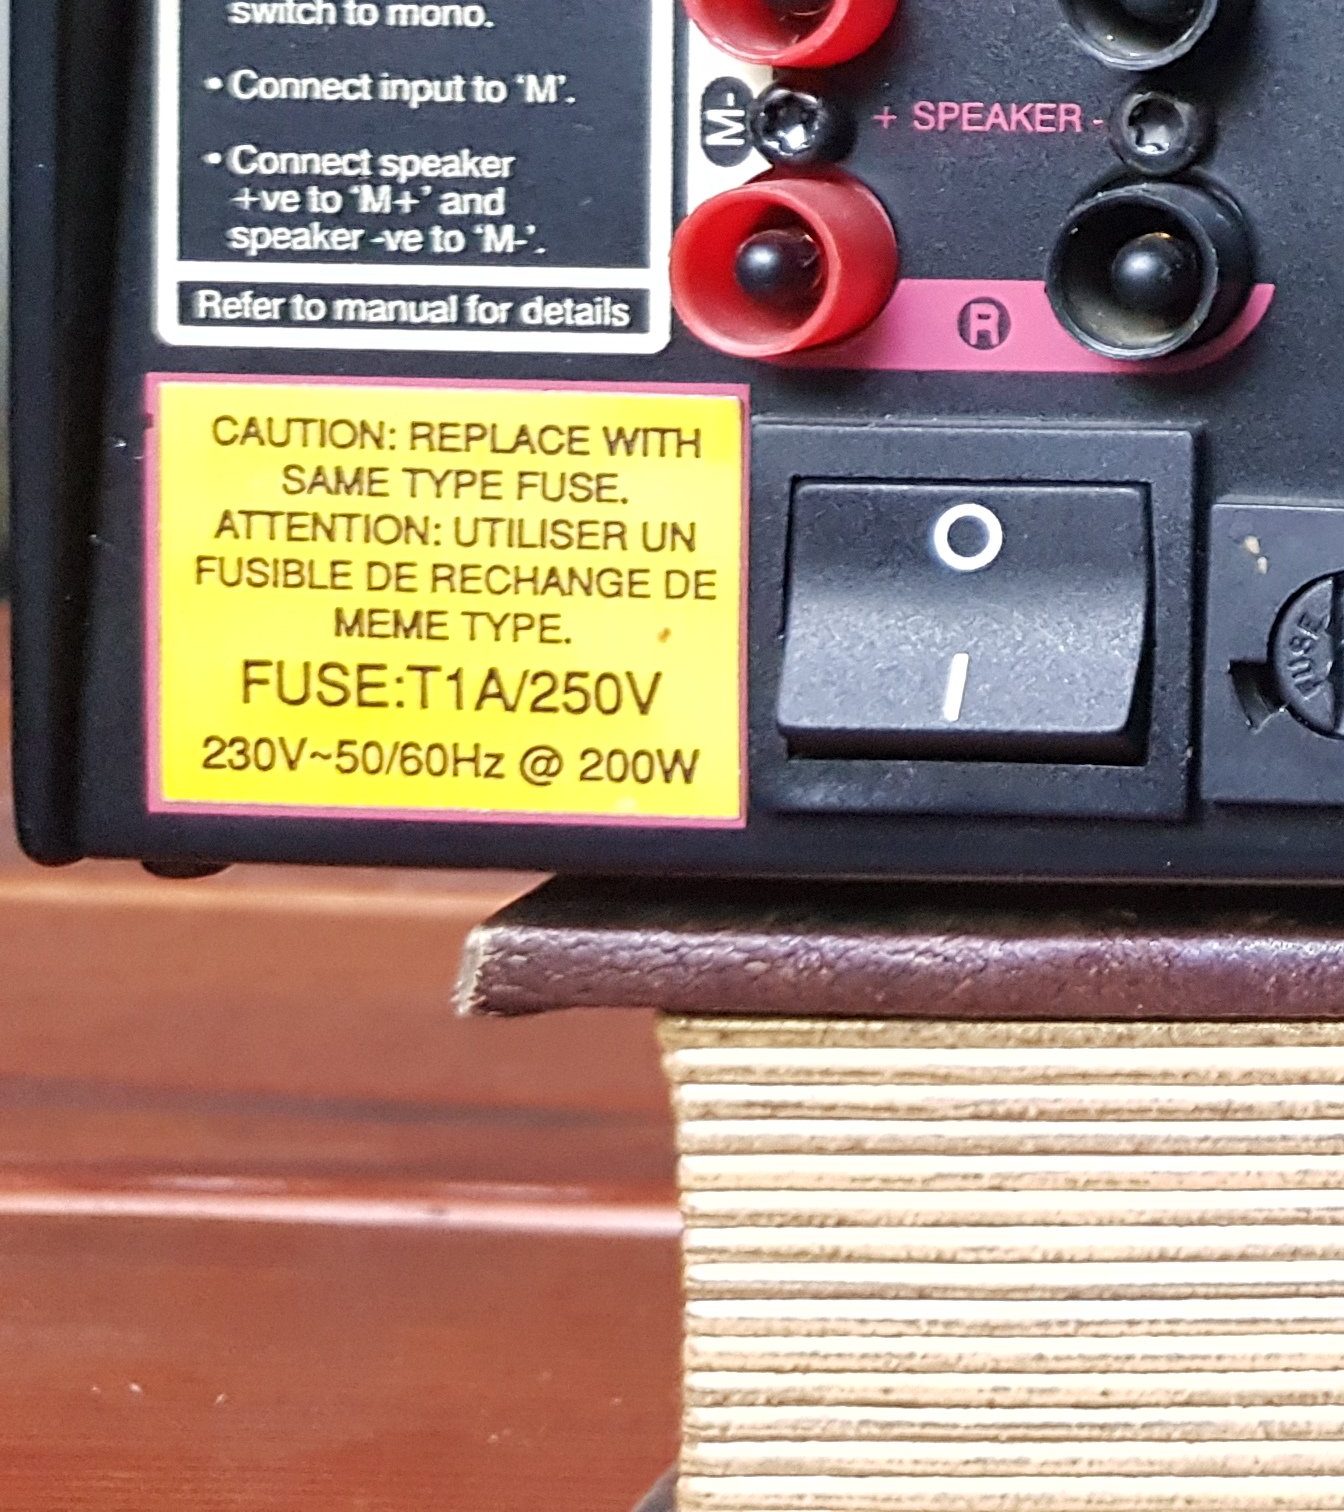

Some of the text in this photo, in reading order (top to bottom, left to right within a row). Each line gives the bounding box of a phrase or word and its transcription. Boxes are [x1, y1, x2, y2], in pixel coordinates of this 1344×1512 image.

[229, 0, 494, 28] switch to mono.
[231, 70, 371, 100] Connect
[380, 76, 465, 108] input
[473, 76, 507, 101] to
[913, 101, 1082, 133] SPEAKER
[229, 145, 515, 184] Connect speaker
[233, 191, 298, 213] +ve
[306, 188, 342, 213] to
[439, 188, 506, 216] and
[228, 226, 364, 255] speaker
[371, 229, 422, 251] -ve
[430, 227, 465, 252] to
[196, 291, 630, 326] Refer to manual for details
[969, 304, 1000, 343] R
[213, 416, 701, 458] CAUTION: REPLACE WITH
[282, 464, 628, 504] SAME TYPE FUSE.
[214, 511, 695, 552] ATTENTION: UTILISER UN
[197, 556, 717, 600] FUSIBLE DE RECHANGE DE
[334, 609, 572, 644] MEME TYPE.
[242, 660, 661, 716] FUSE:T1A/250V
[520, 746, 563, 785] @
[580, 748, 699, 784] 200W
